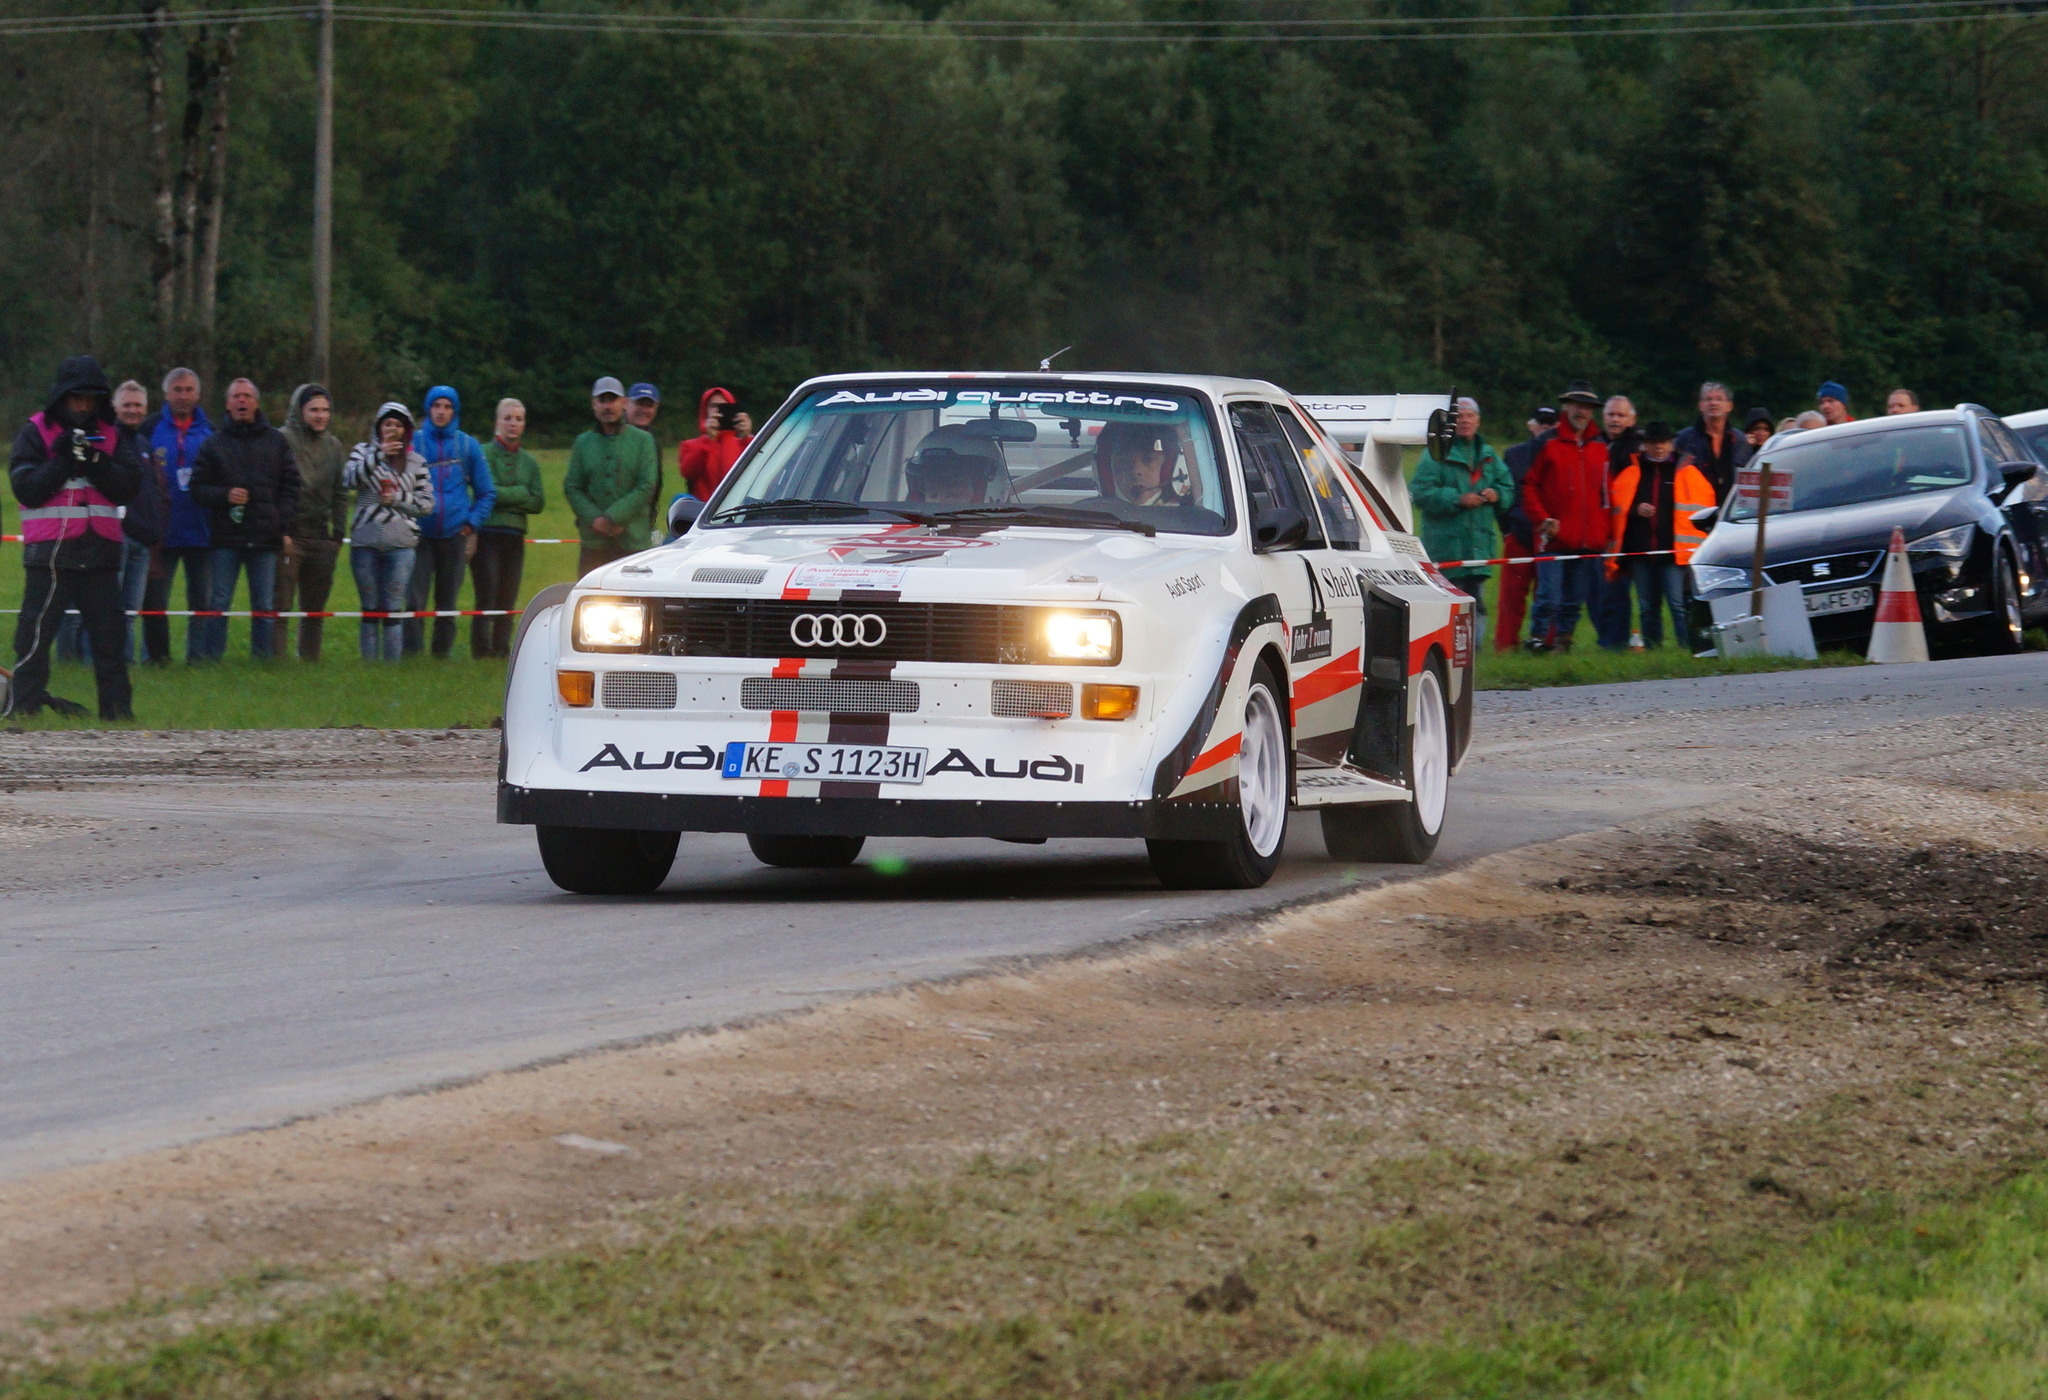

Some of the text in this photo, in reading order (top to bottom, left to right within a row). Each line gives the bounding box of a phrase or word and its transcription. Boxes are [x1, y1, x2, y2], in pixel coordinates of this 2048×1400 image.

[815, 388, 1179, 412] Audi quattro
[1320, 566, 1359, 599] Shell
[577, 743, 727, 773] Audi
[745, 747, 784, 774] KE
[803, 747, 823, 774] S
[828, 749, 922, 778] 1123H
[926, 748, 1084, 784] Audi
